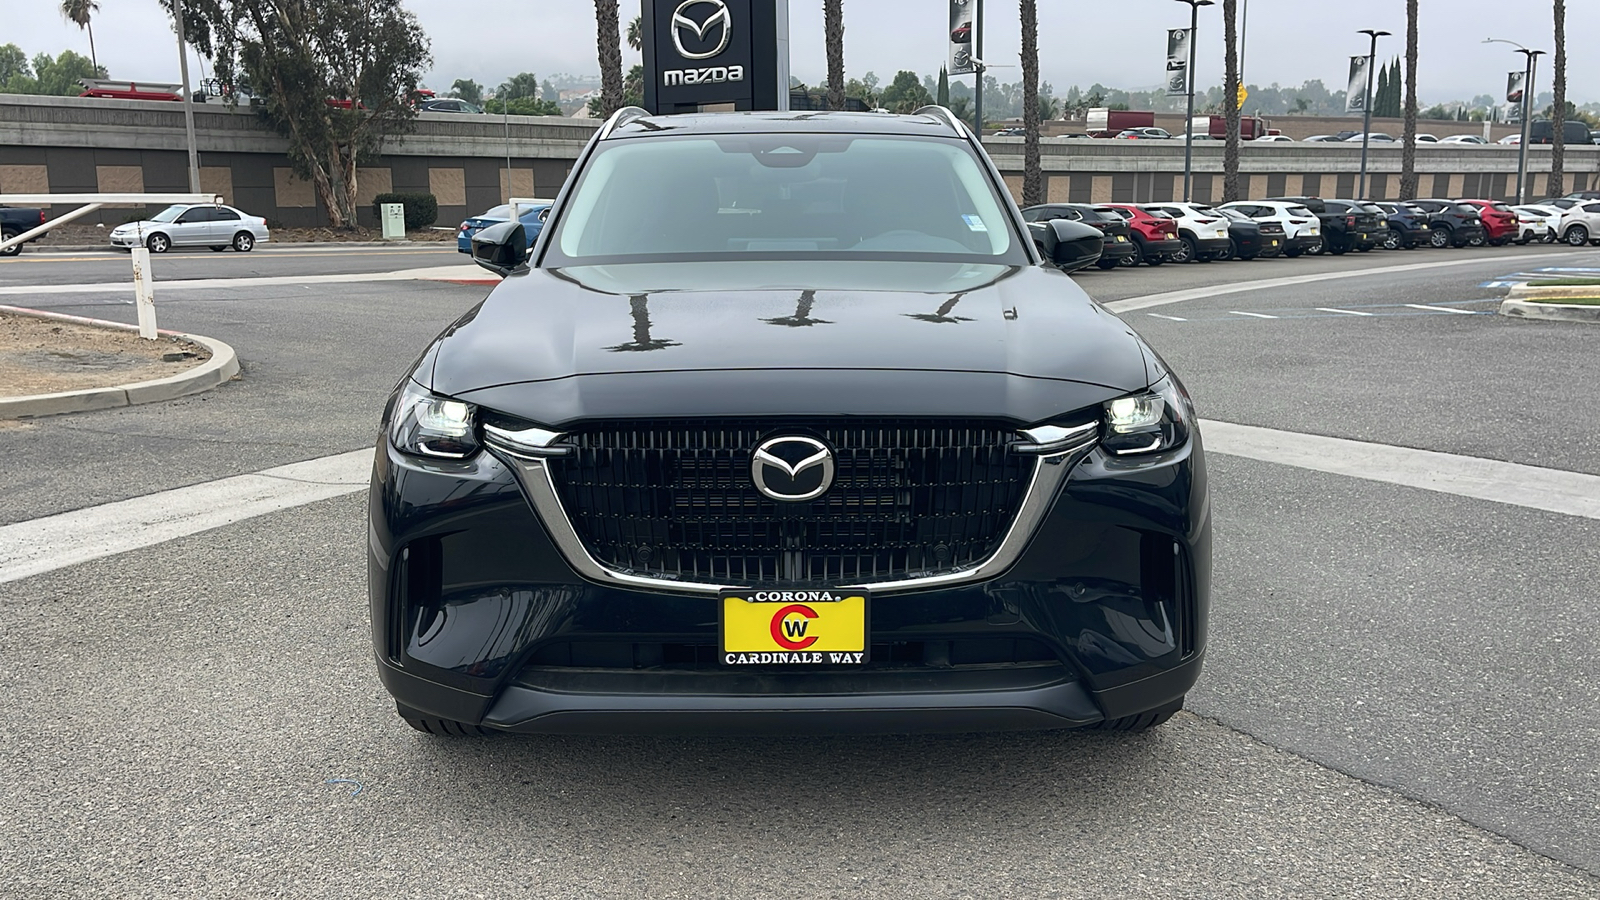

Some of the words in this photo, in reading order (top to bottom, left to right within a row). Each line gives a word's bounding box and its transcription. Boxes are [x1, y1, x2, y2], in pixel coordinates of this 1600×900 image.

[755, 591, 834, 602] CORONA
[725, 652, 823, 664] CARDINALE
[829, 652, 865, 664] WAY
